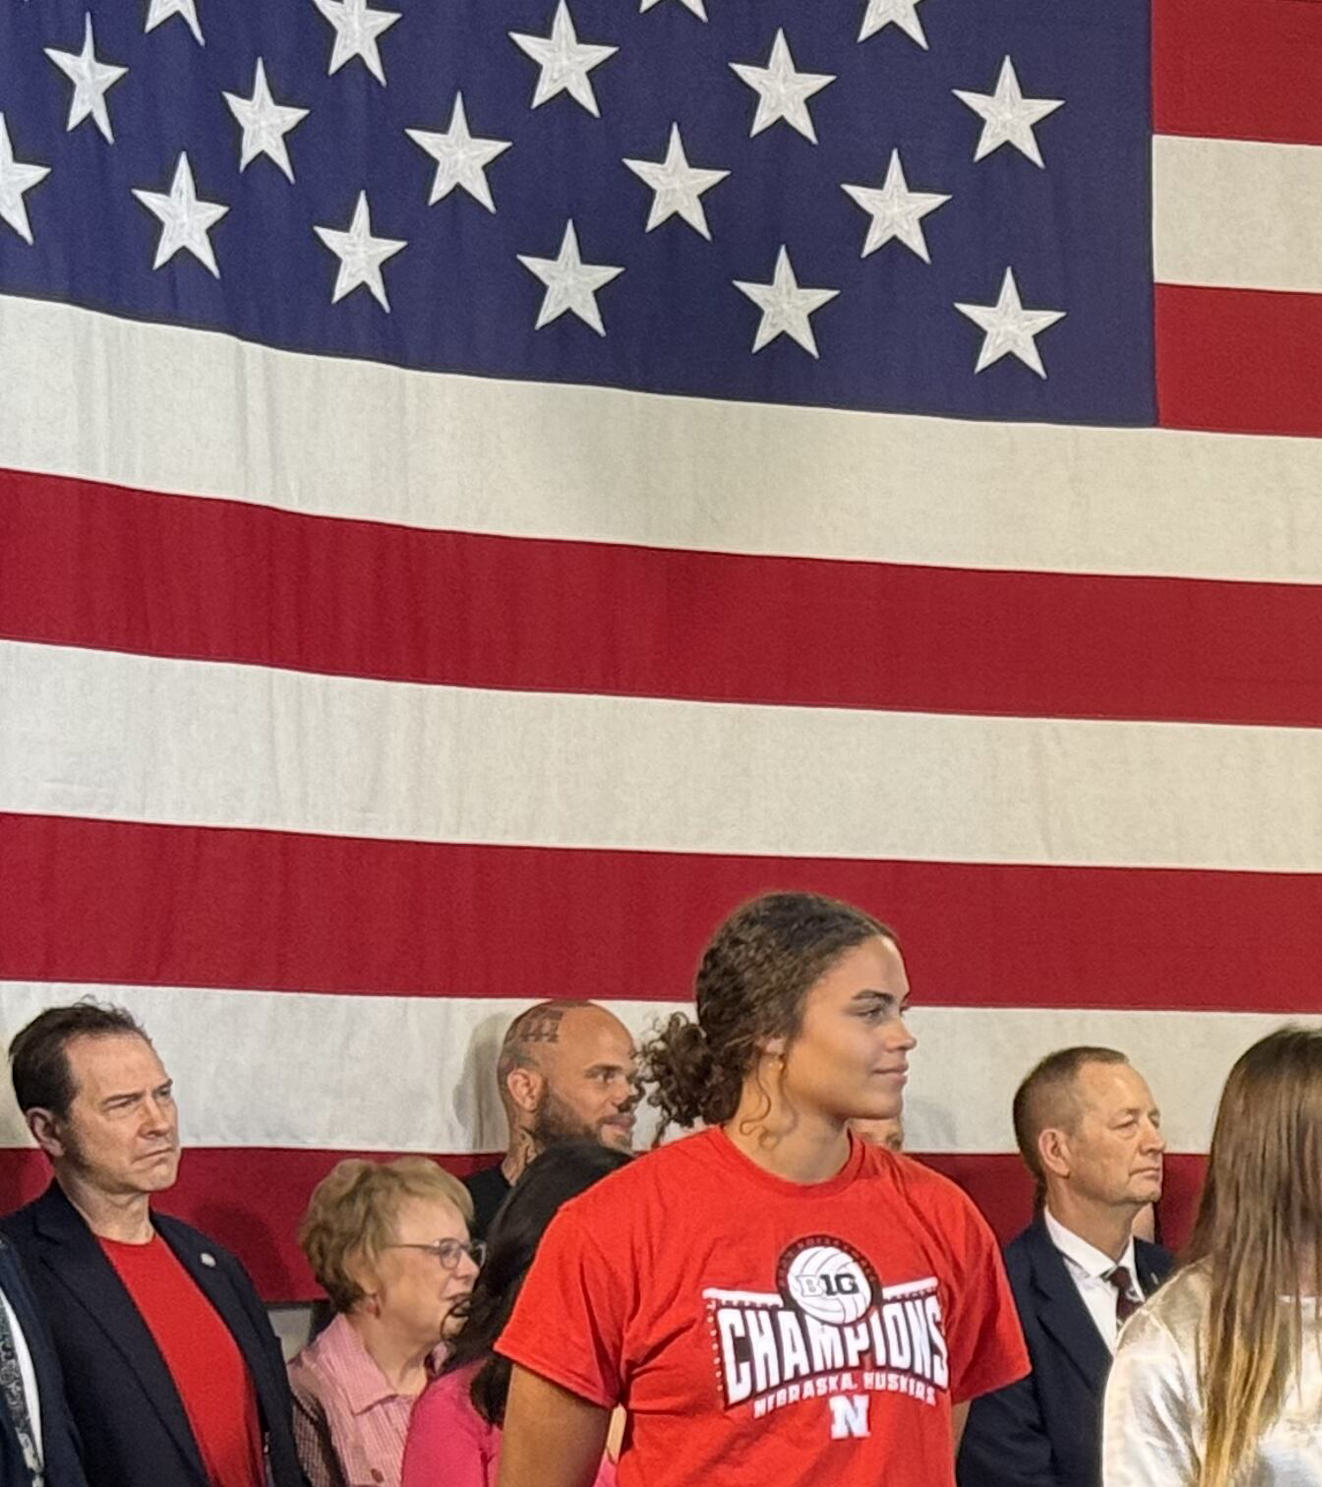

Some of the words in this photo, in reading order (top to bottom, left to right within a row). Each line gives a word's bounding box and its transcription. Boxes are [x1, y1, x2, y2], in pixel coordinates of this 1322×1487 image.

[717, 1295, 948, 1404] CHAMPIONS
[754, 1372, 857, 1418] NEBRASKA
[829, 1394, 871, 1439] N
